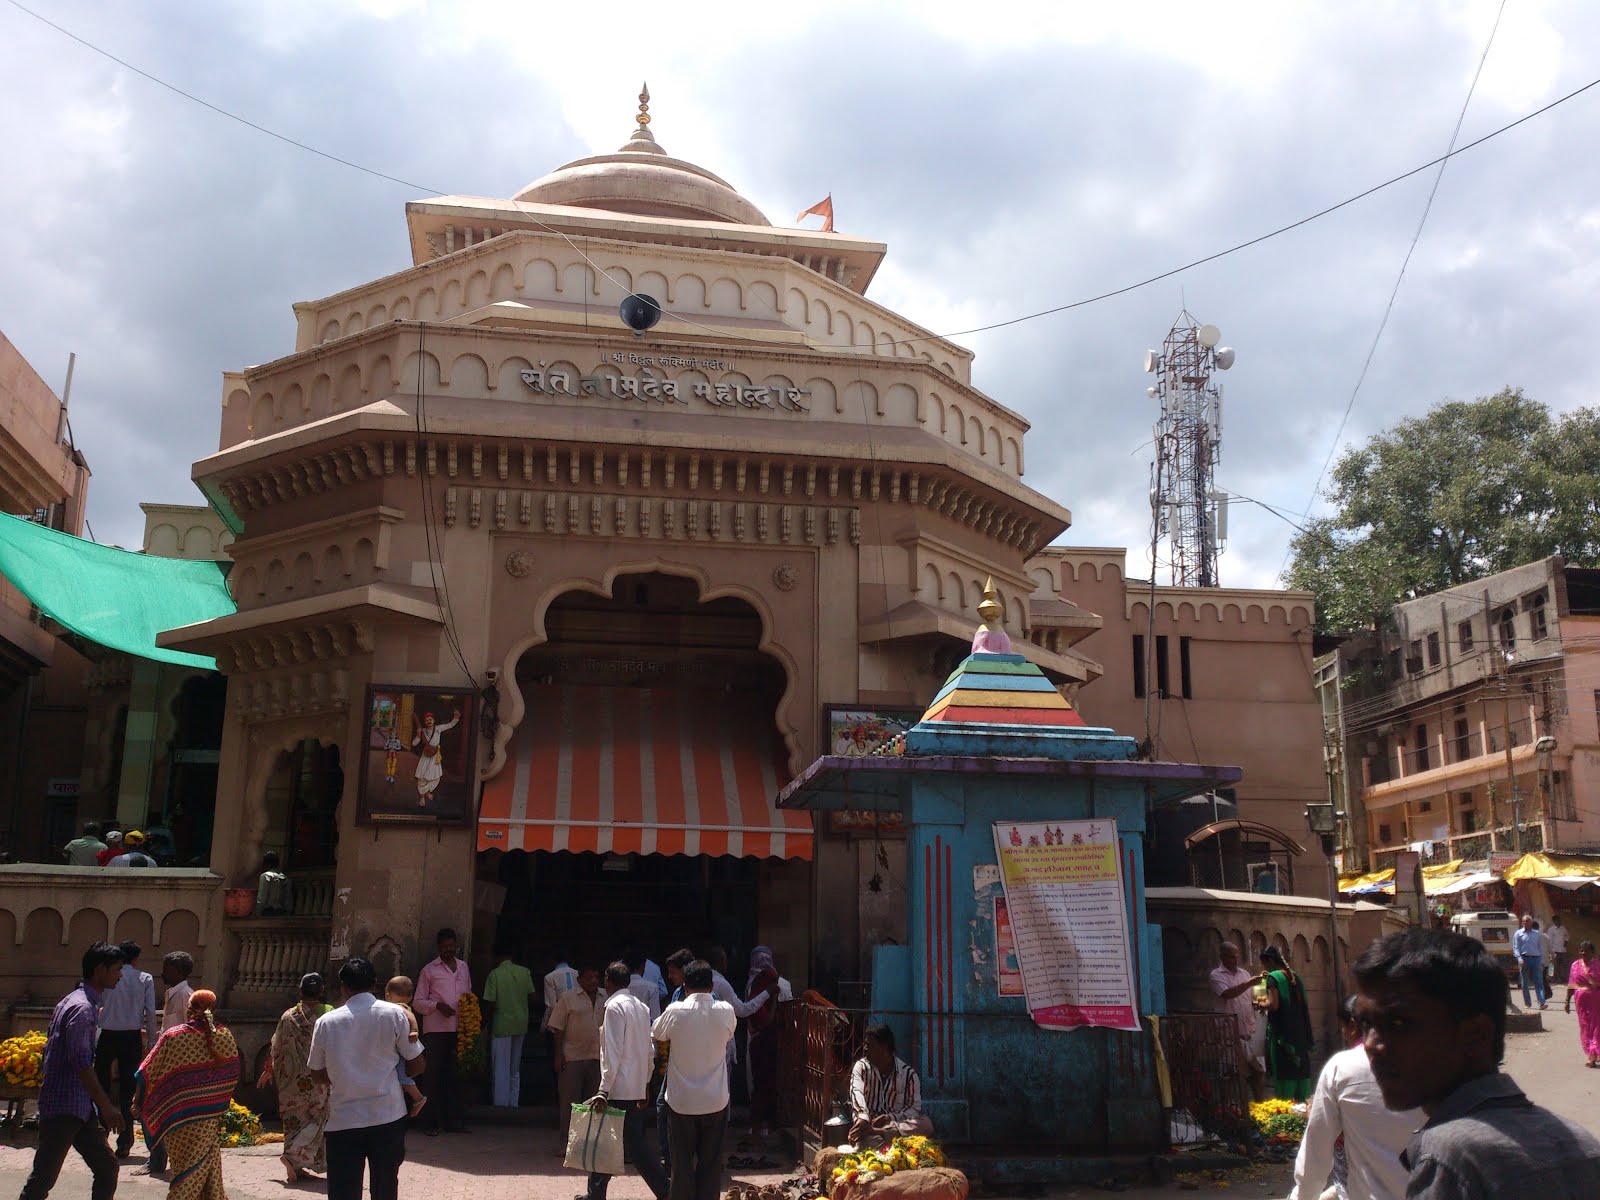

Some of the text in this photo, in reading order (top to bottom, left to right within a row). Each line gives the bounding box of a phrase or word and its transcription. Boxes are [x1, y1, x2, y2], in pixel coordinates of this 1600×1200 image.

[612, 352, 625, 363] श्री
[520, 359, 579, 399] संत
[579, 366, 689, 406] नामदेव
